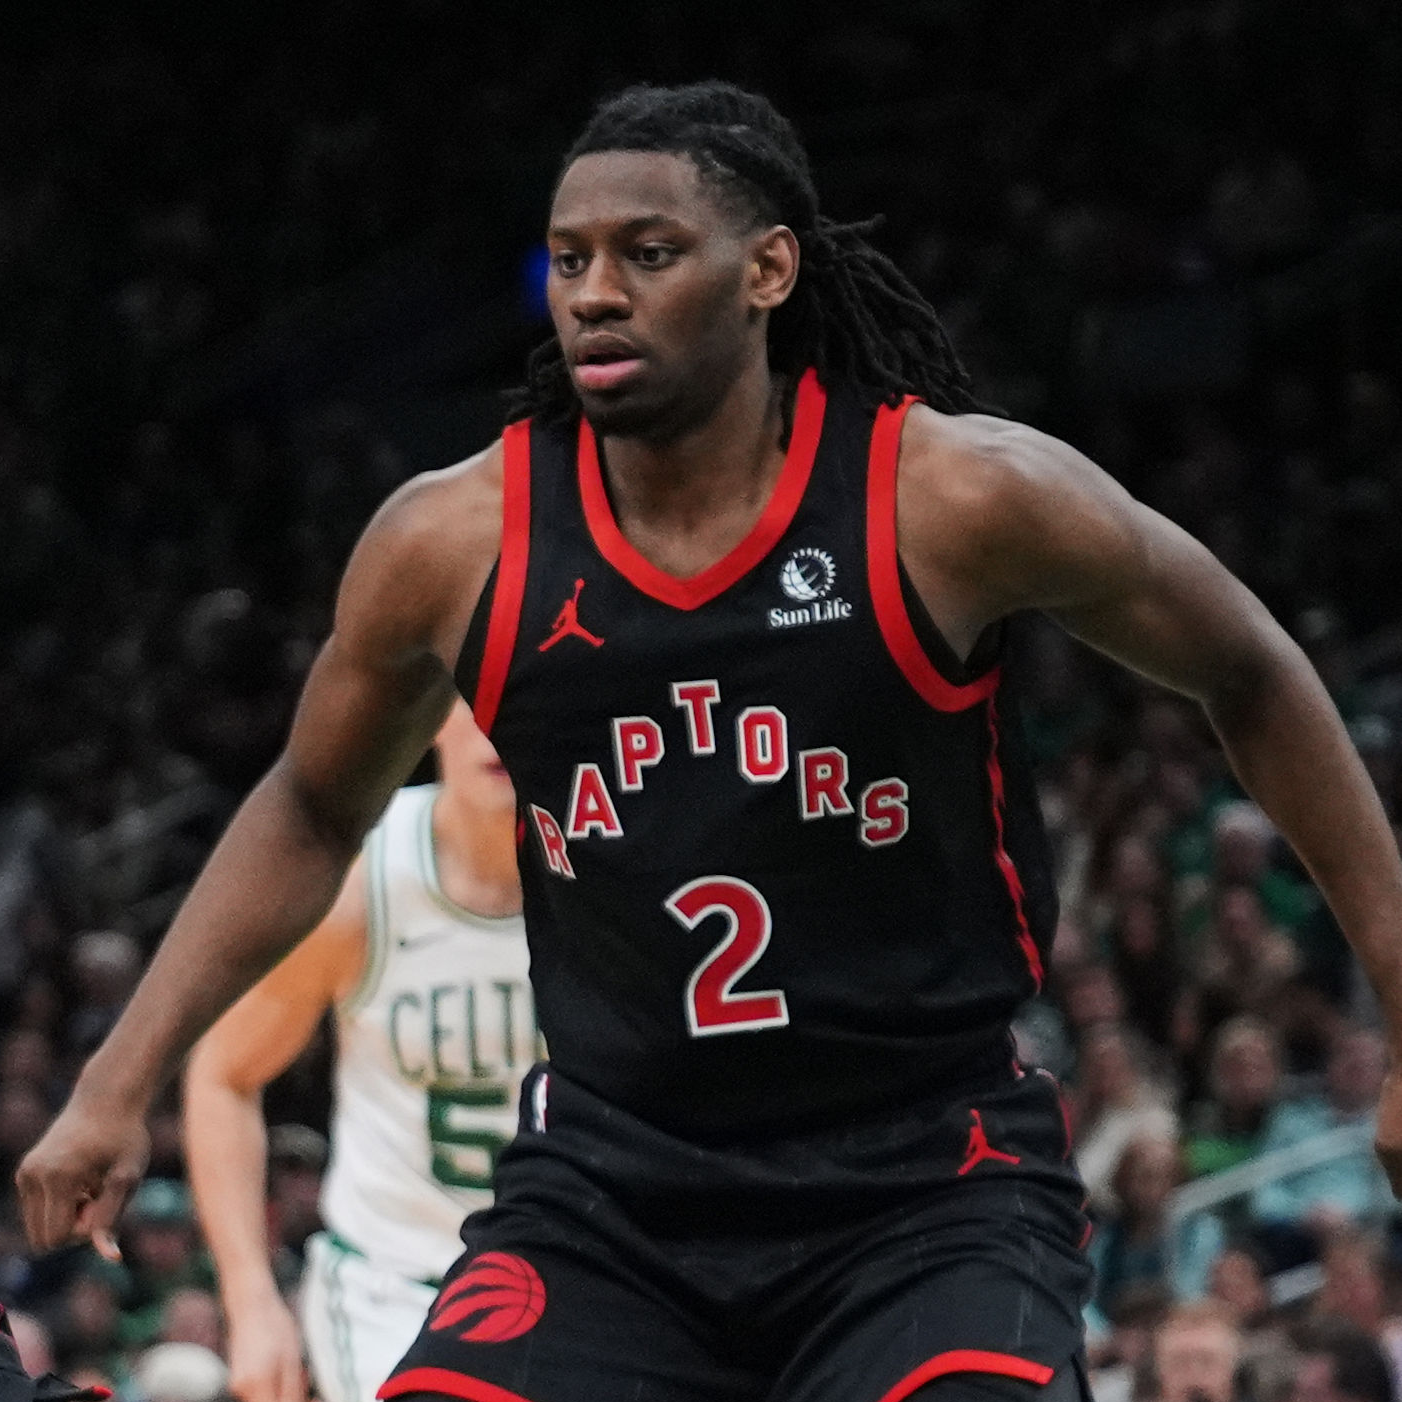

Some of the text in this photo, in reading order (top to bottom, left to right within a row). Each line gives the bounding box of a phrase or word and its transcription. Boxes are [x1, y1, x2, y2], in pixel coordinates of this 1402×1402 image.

[769, 597, 853, 628] Sun Life
[529, 679, 909, 880] RAPTORS
[663, 874, 790, 1038] 2
